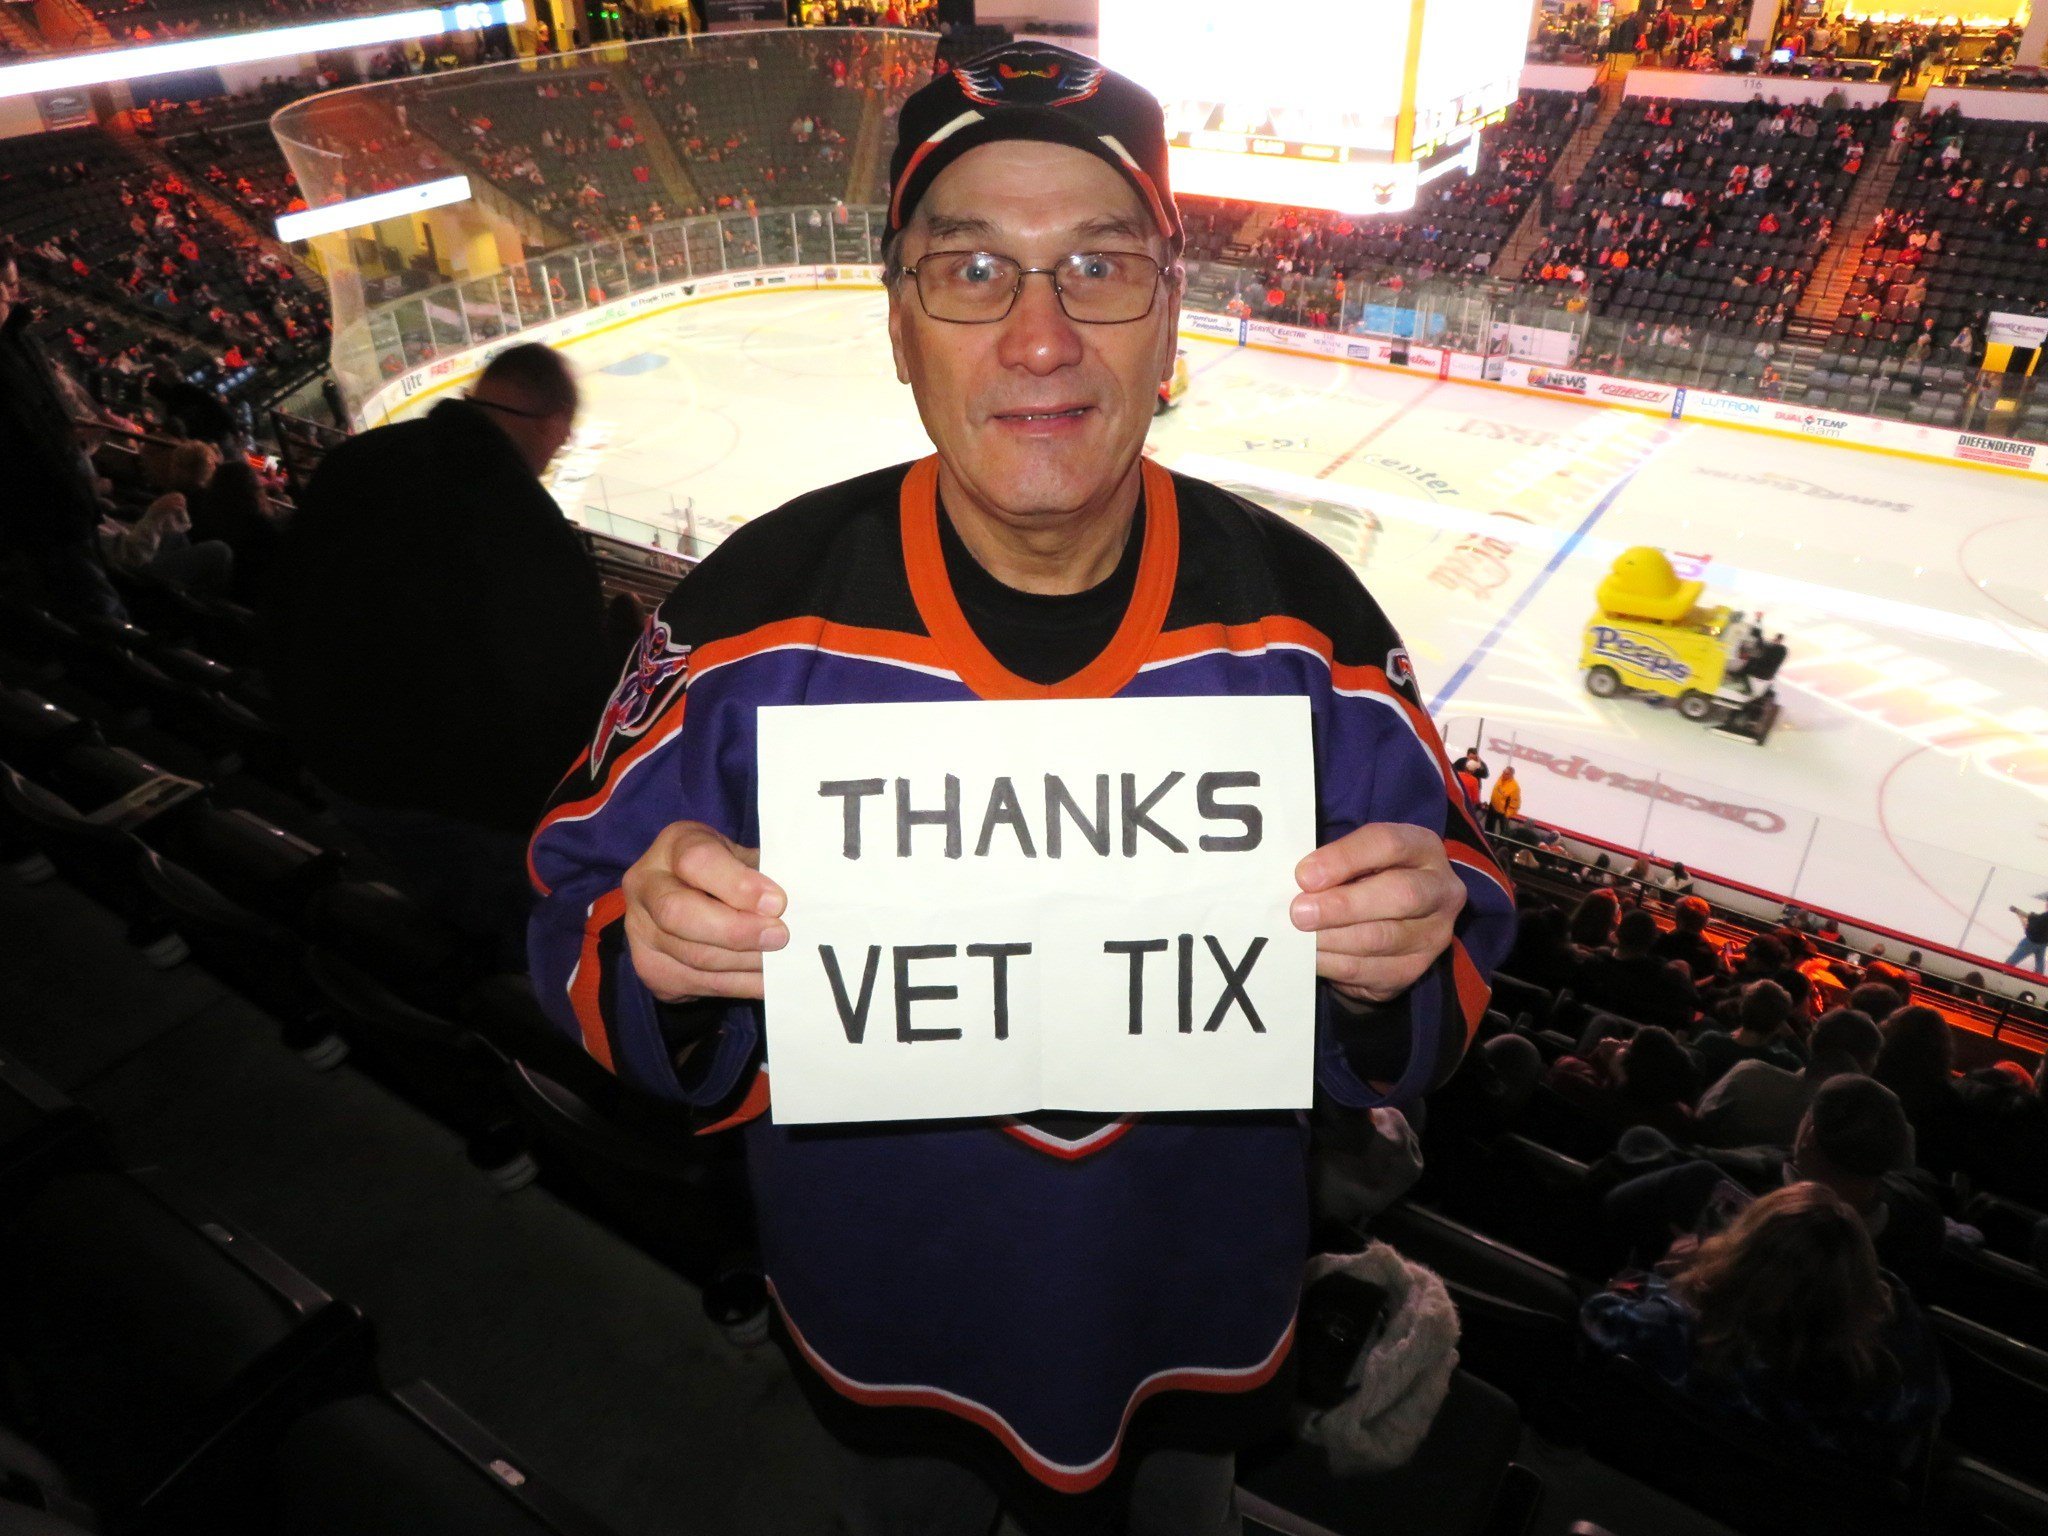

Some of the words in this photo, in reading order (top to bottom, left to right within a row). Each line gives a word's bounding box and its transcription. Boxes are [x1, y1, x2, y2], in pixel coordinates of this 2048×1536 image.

[1546, 372, 1587, 390] NEWS
[1701, 397, 1760, 414] LUTRON
[1801, 423, 1841, 438] team
[1816, 417, 1848, 429] TEMP
[1957, 434, 2036, 457] DIEFENDERFER
[817, 770, 1263, 860] THANKS
[818, 942, 1033, 1045] VET
[1104, 933, 1269, 1036] TIX
